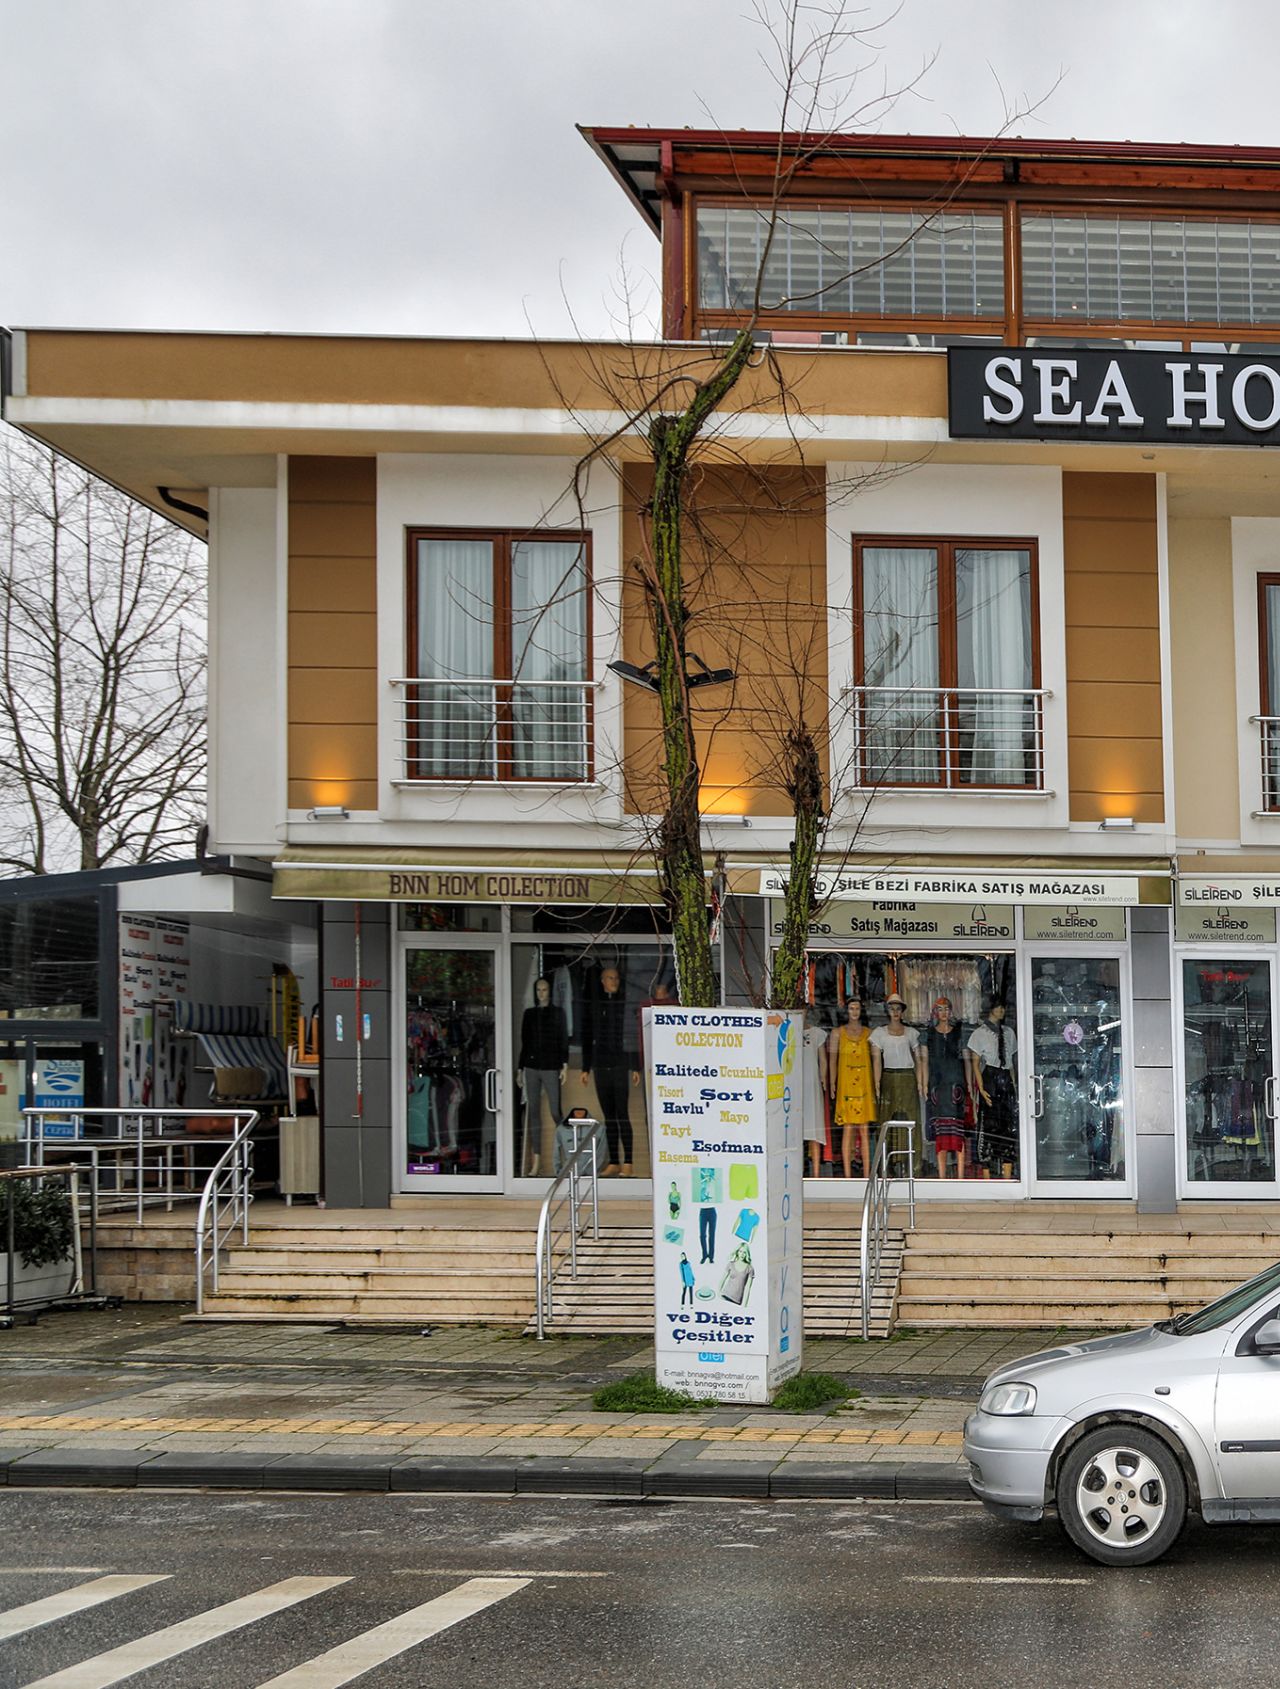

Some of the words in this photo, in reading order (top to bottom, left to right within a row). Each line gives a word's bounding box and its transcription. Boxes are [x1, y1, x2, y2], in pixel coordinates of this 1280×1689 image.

[982, 356, 1145, 427] SEA
[389, 874, 430, 895] BNN
[437, 875, 480, 896] HOM
[487, 876, 590, 897] COLECTION
[875, 878, 909, 892] BEZİ
[914, 879, 977, 894] FABRİKA
[982, 883, 1025, 897] SATIŞ
[1029, 881, 1105, 896] MAĞAZASI
[851, 917, 880, 935] Satış
[884, 918, 938, 935] Mağazası
[1037, 930, 1114, 940] www.siletrend.com
[1188, 931, 1264, 942] www.siletrend.com
[654, 1013, 688, 1026] BNN
[691, 1015, 763, 1028] CLOTHES
[675, 1032, 743, 1048] COLECTION
[655, 1063, 718, 1078] Kalitede
[719, 1065, 764, 1079] Ucuzluk
[719, 1110, 750, 1125] Mayo
[660, 1123, 692, 1138] Tayt
[666, 1313, 690, 1323] ve
[695, 1312, 755, 1327] Diğer
